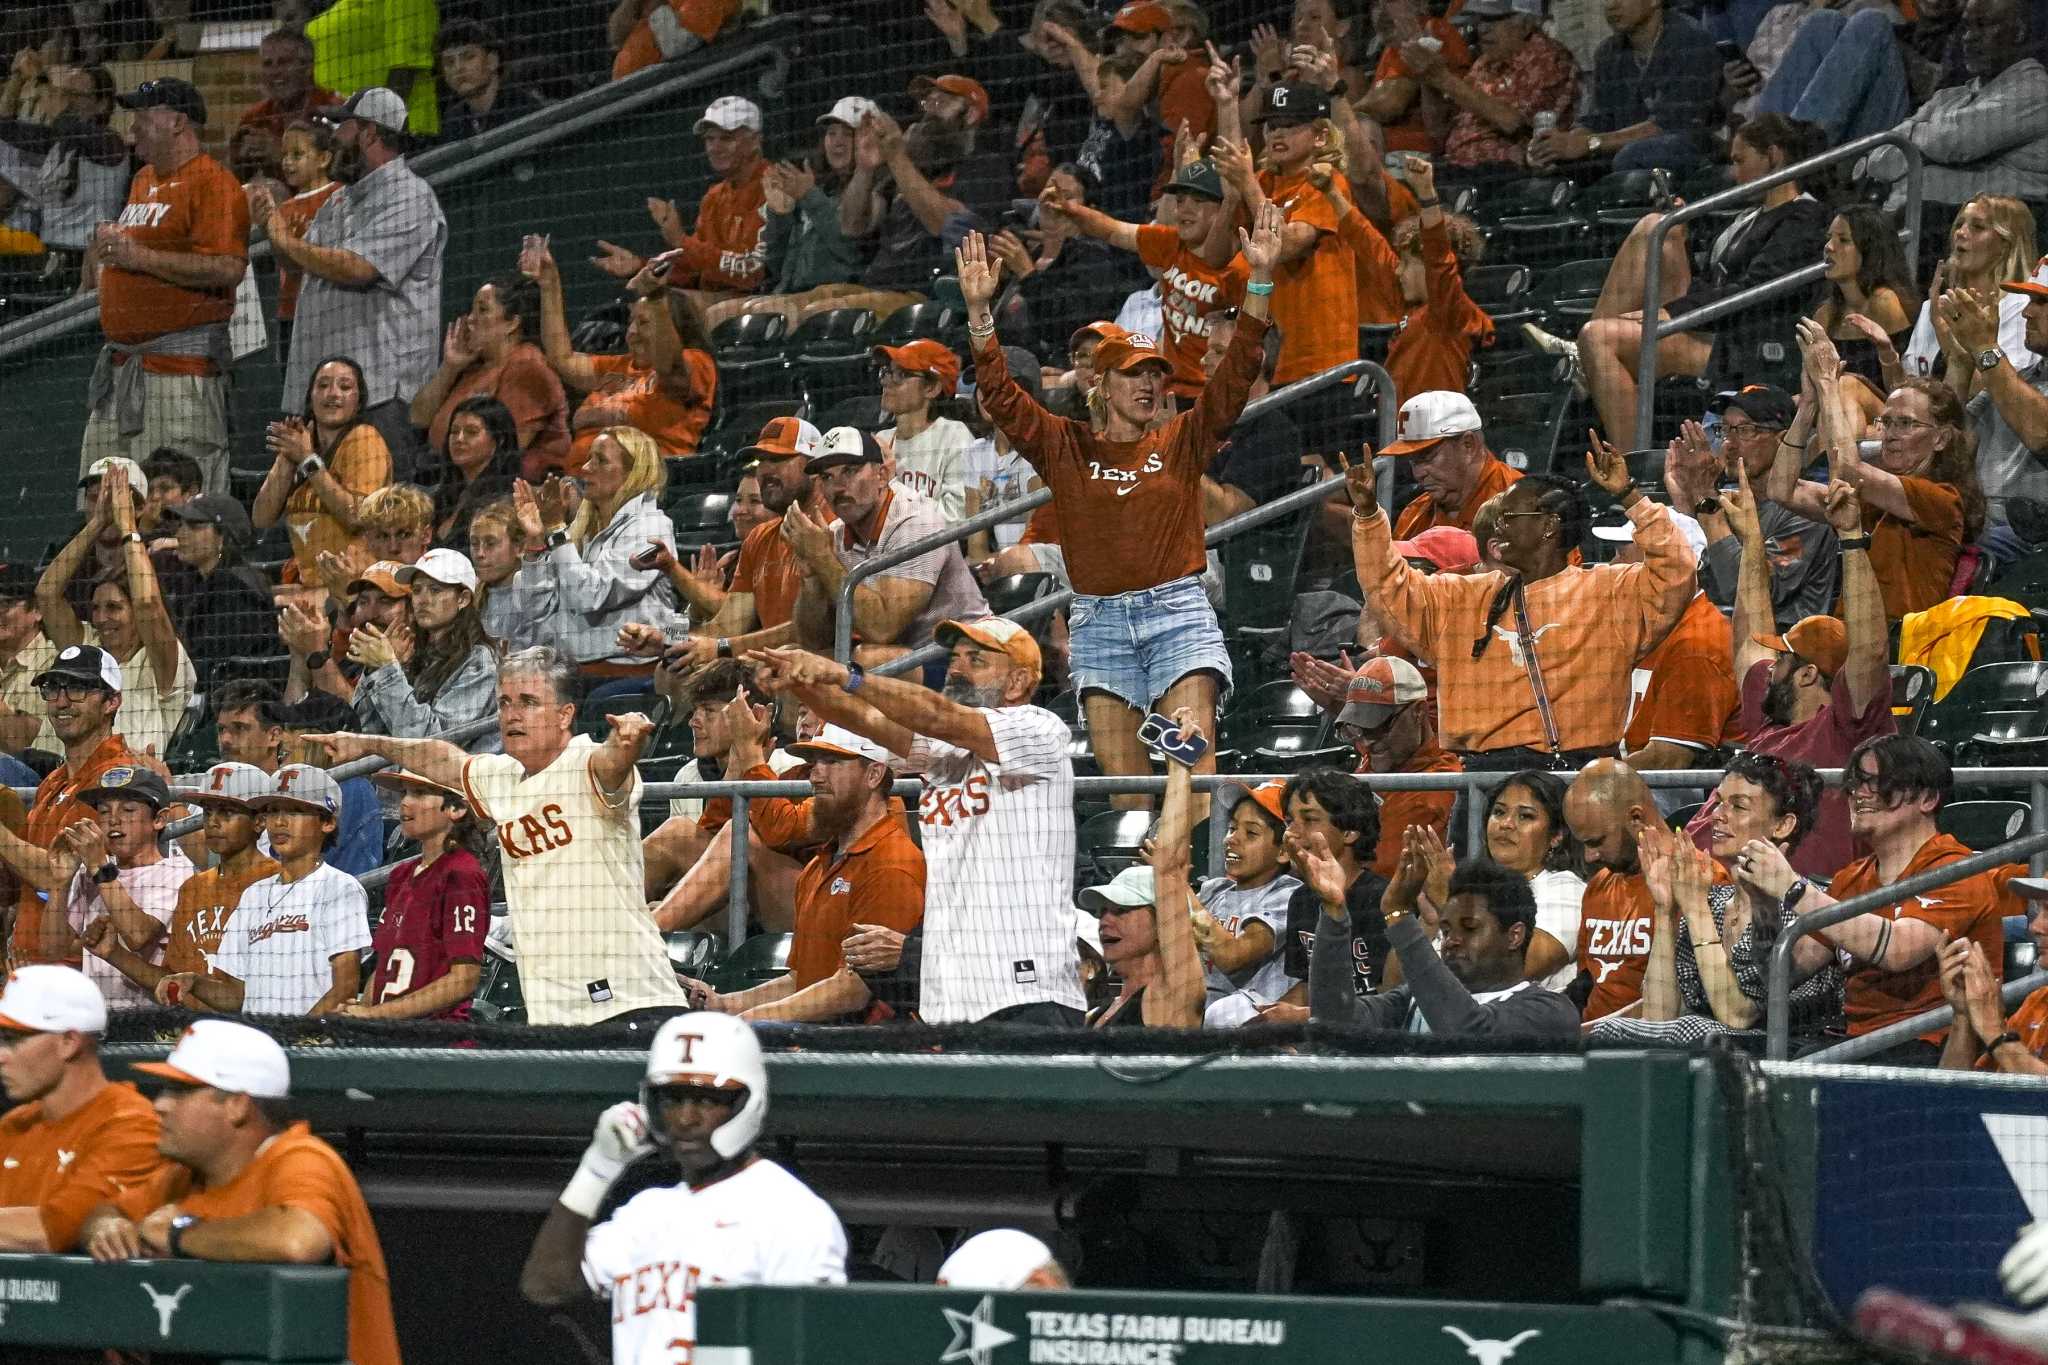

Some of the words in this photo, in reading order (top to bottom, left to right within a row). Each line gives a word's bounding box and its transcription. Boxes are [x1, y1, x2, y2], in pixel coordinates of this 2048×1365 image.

[210, 767, 234, 791] T
[277, 770, 300, 792] T
[186, 905, 228, 943] TEX
[453, 904, 476, 934] 12
[1585, 917, 1651, 955] TEXAS
[674, 1032, 705, 1064] T
[8, 1278, 61, 1302] BUREAU
[612, 1261, 702, 1325] TEXA
[1026, 1311, 1109, 1338] TEXAS
[1110, 1313, 1181, 1341] FARM
[1183, 1316, 1287, 1344] BUREAU
[1029, 1338, 1176, 1365] INSURANCE
